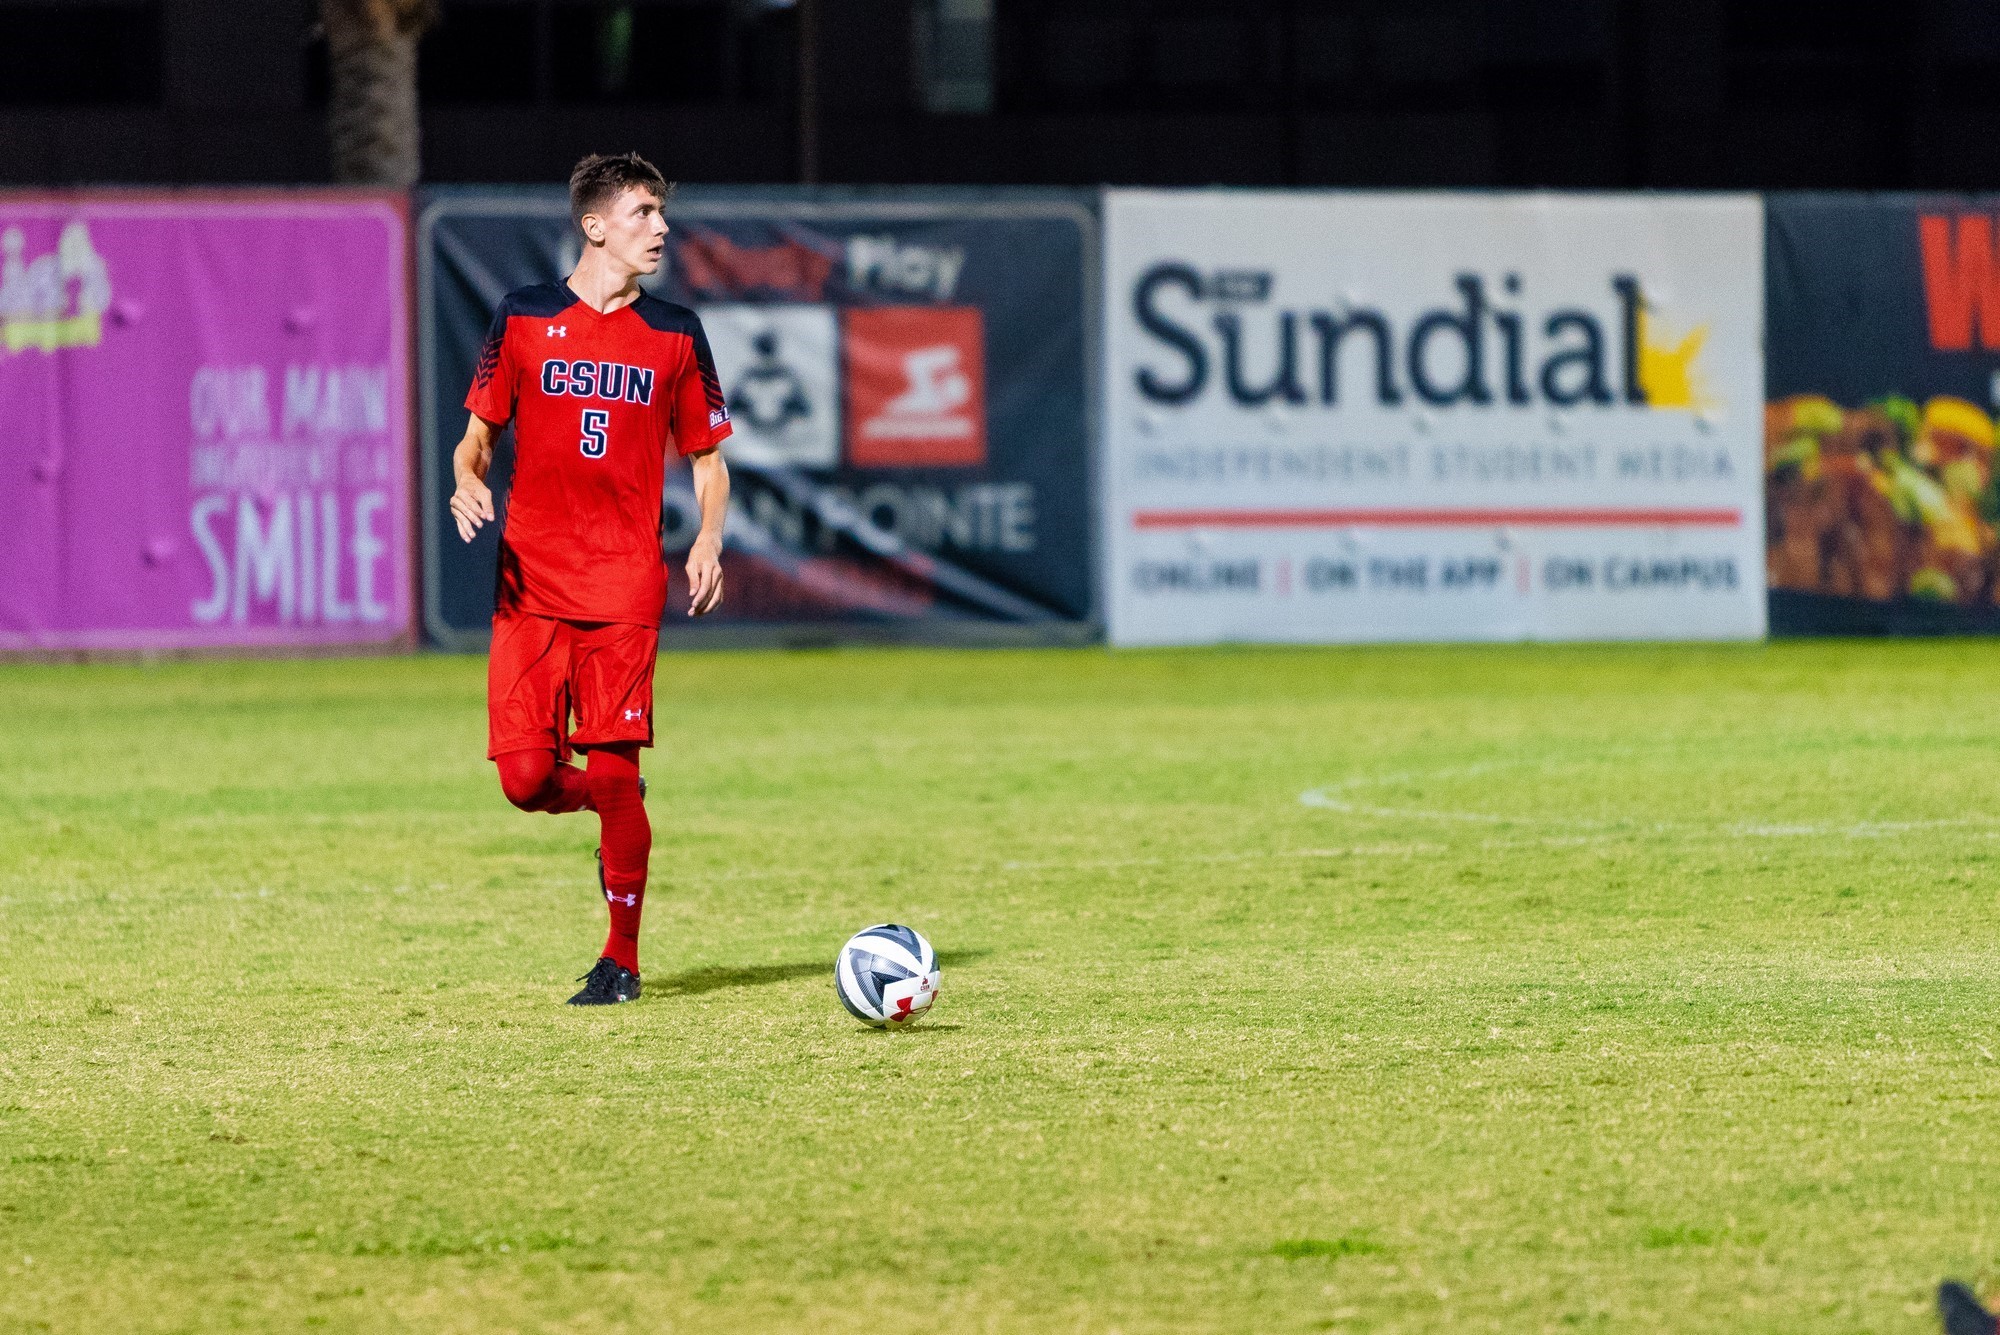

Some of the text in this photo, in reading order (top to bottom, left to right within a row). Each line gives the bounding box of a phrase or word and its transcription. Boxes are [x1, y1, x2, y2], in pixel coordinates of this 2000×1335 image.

[847, 236, 963, 300] Play
[1132, 260, 1648, 407] Sundial
[284, 364, 387, 433] MAIN
[540, 359, 654, 405] CSUN
[580, 409, 609, 459] 5
[1432, 443, 1597, 482] STUDENT
[1616, 445, 1738, 480] MEDIA
[190, 491, 386, 623] SMILE
[1131, 555, 1739, 594] ONLINE ON THE APP ON CAMPUS
